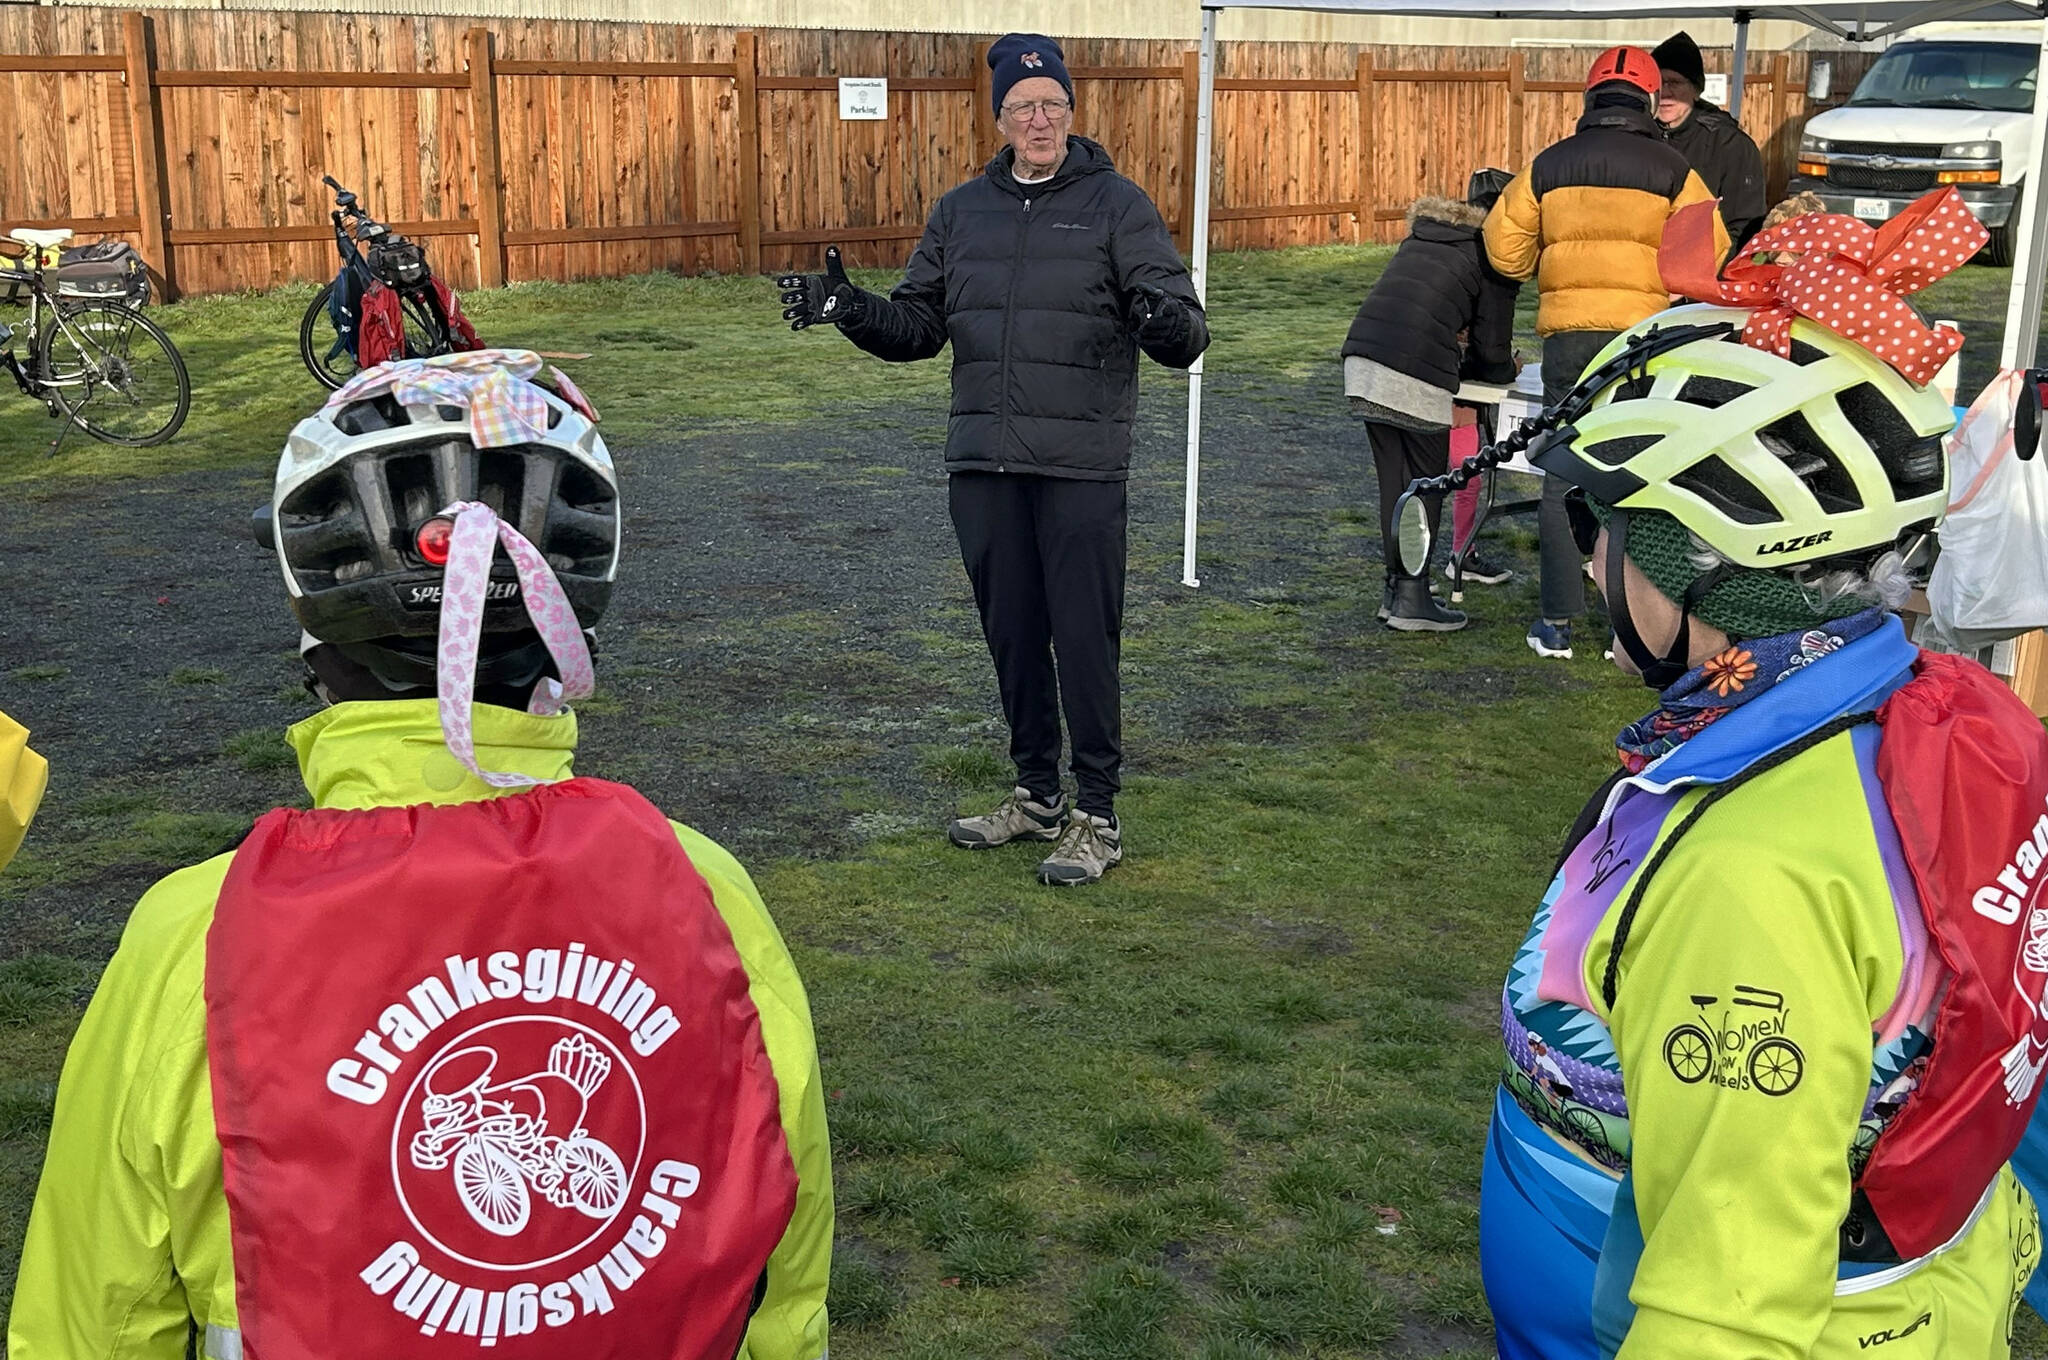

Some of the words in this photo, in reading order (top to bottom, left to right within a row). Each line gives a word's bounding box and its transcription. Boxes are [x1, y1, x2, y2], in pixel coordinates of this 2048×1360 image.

[1756, 530, 1834, 556] LAZER
[409, 580, 519, 603] SPEZED
[326, 941, 681, 1105] Cranksgiving
[359, 1159, 701, 1347] Cranksgiving
